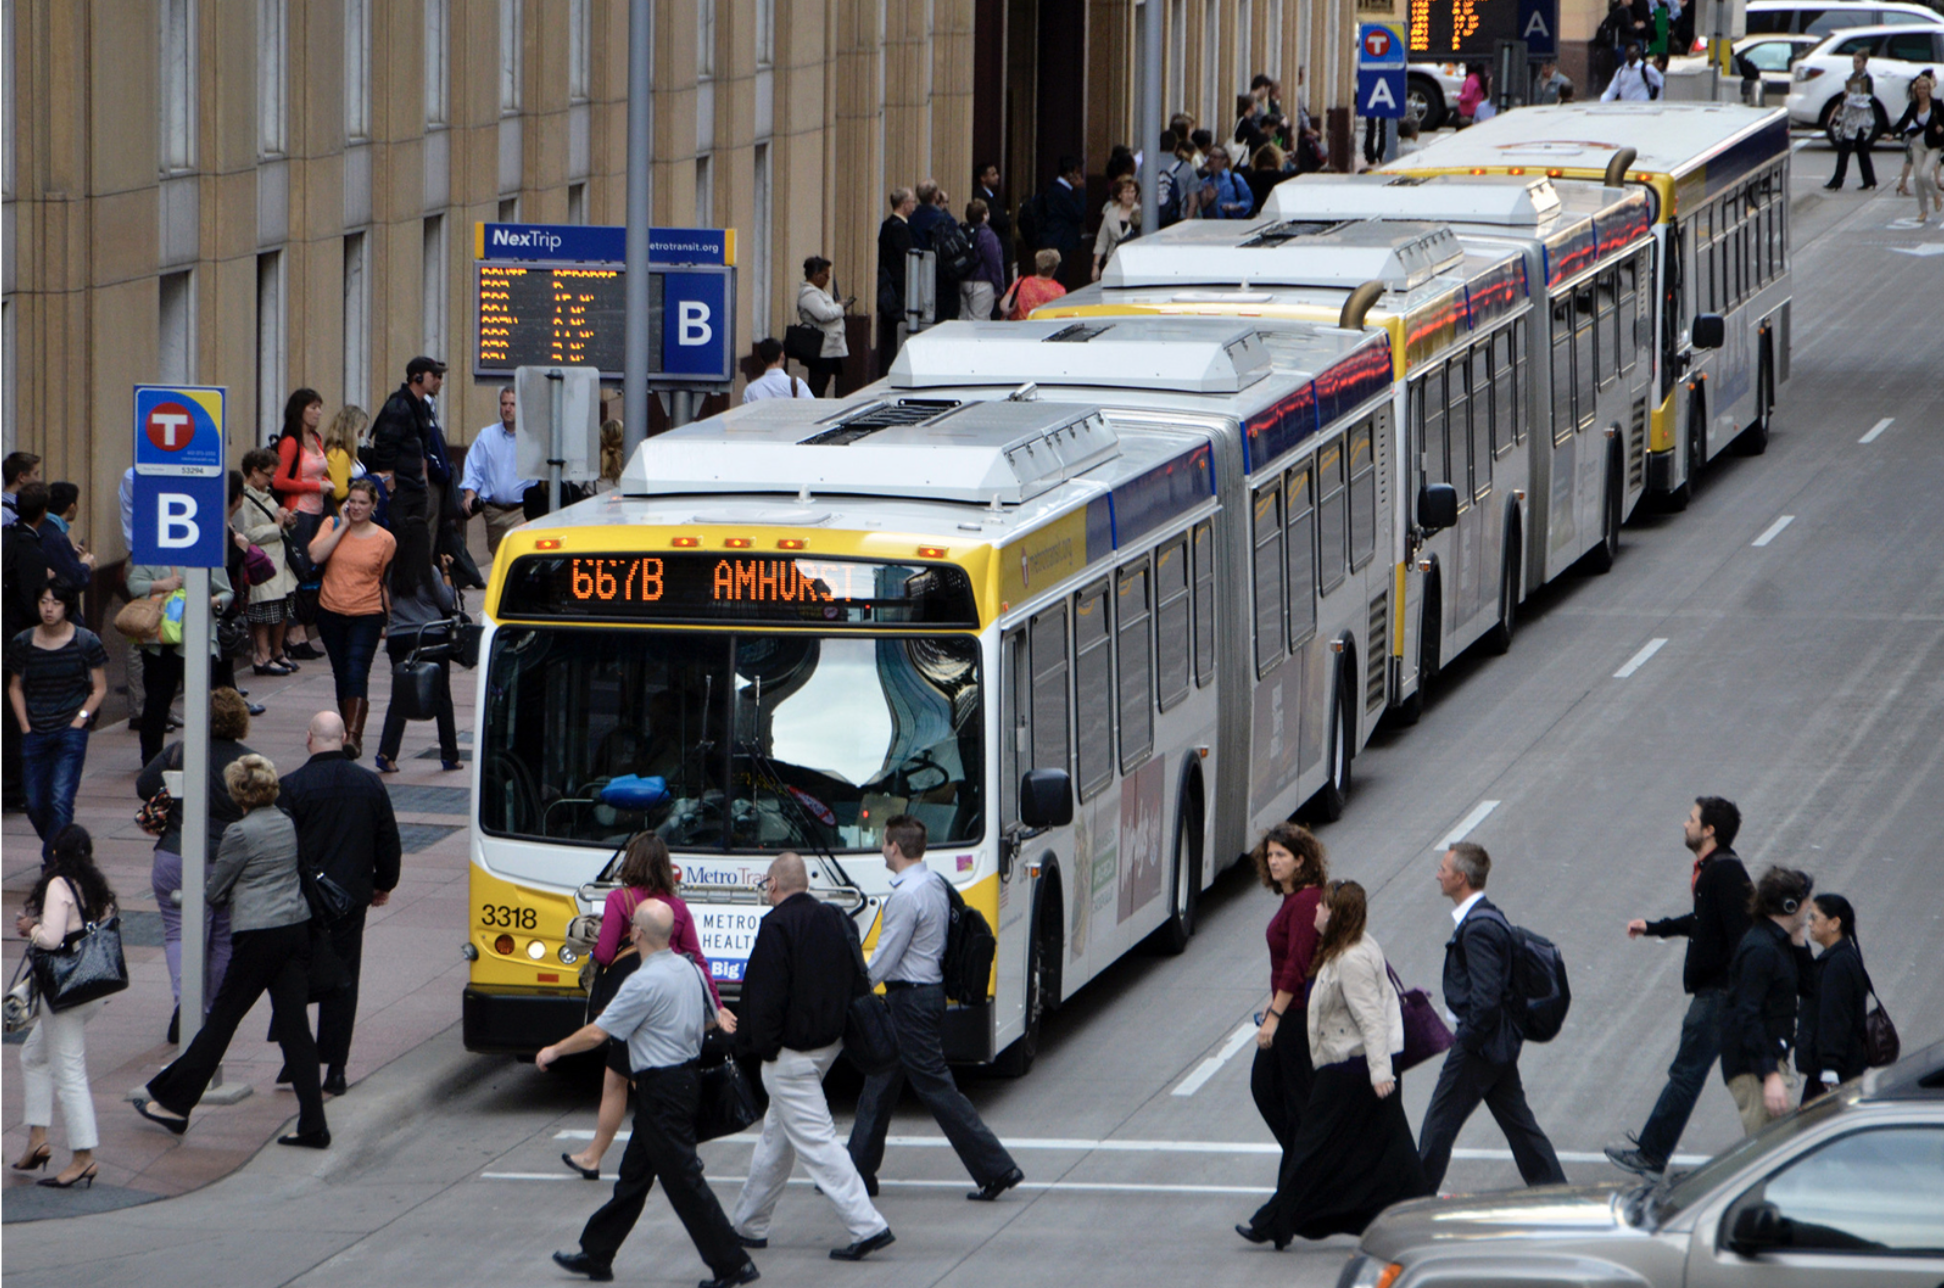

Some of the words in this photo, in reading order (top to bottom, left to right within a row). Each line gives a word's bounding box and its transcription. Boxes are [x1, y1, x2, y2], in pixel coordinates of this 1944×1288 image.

[1523, 10, 1549, 38] A
[1367, 35, 1387, 54] T
[1367, 77, 1396, 109] A
[493, 229, 562, 252] NexTrip
[649, 242, 719, 254] etrotransit.org
[678, 301, 713, 346] B
[151, 413, 188, 446] T
[181, 466, 204, 475] 53294
[157, 493, 200, 548] B
[572, 558, 664, 601] 667B
[713, 559, 855, 602] AMHURST
[481, 903, 537, 930] 3318
[703, 914, 757, 930] METRO
[711, 961, 740, 980] Big
